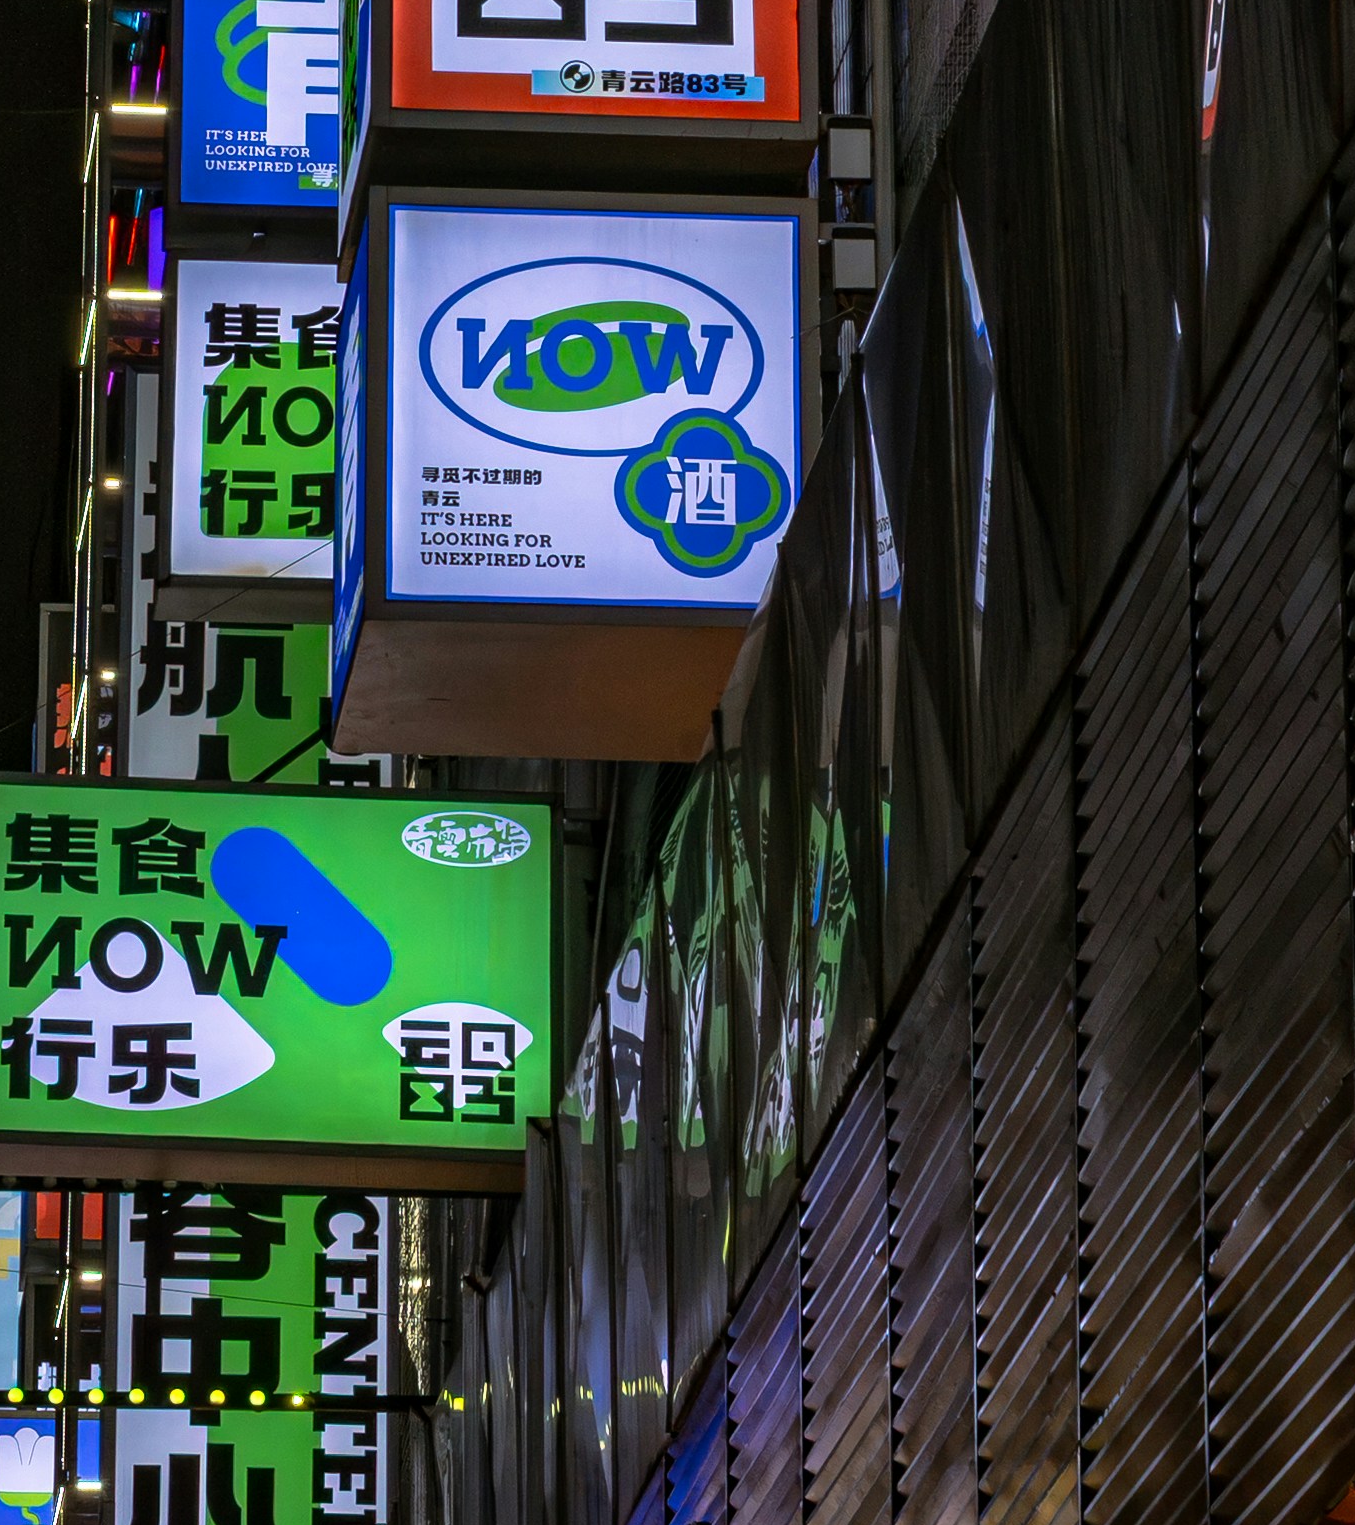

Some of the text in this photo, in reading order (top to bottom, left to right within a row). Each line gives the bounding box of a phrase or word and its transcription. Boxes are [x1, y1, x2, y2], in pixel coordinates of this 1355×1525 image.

[601, 69, 748, 96] 青云路83号
[205, 129, 234, 142] IT'S
[205, 145, 311, 158] LOOKING FOR
[204, 160, 294, 174] UNEXPIRED
[421, 466, 543, 486] 寻觅不过期的
[421, 490, 461, 507] 青云
[663, 455, 738, 526] 酒
[420, 511, 513, 527] IT'S HERE
[420, 531, 553, 548] LOOKING FOR
[420, 551, 586, 569] UNEXPIRED LOVE
[3, 812, 207, 900] 集食
[0, 1015, 201, 1104] 行乐
